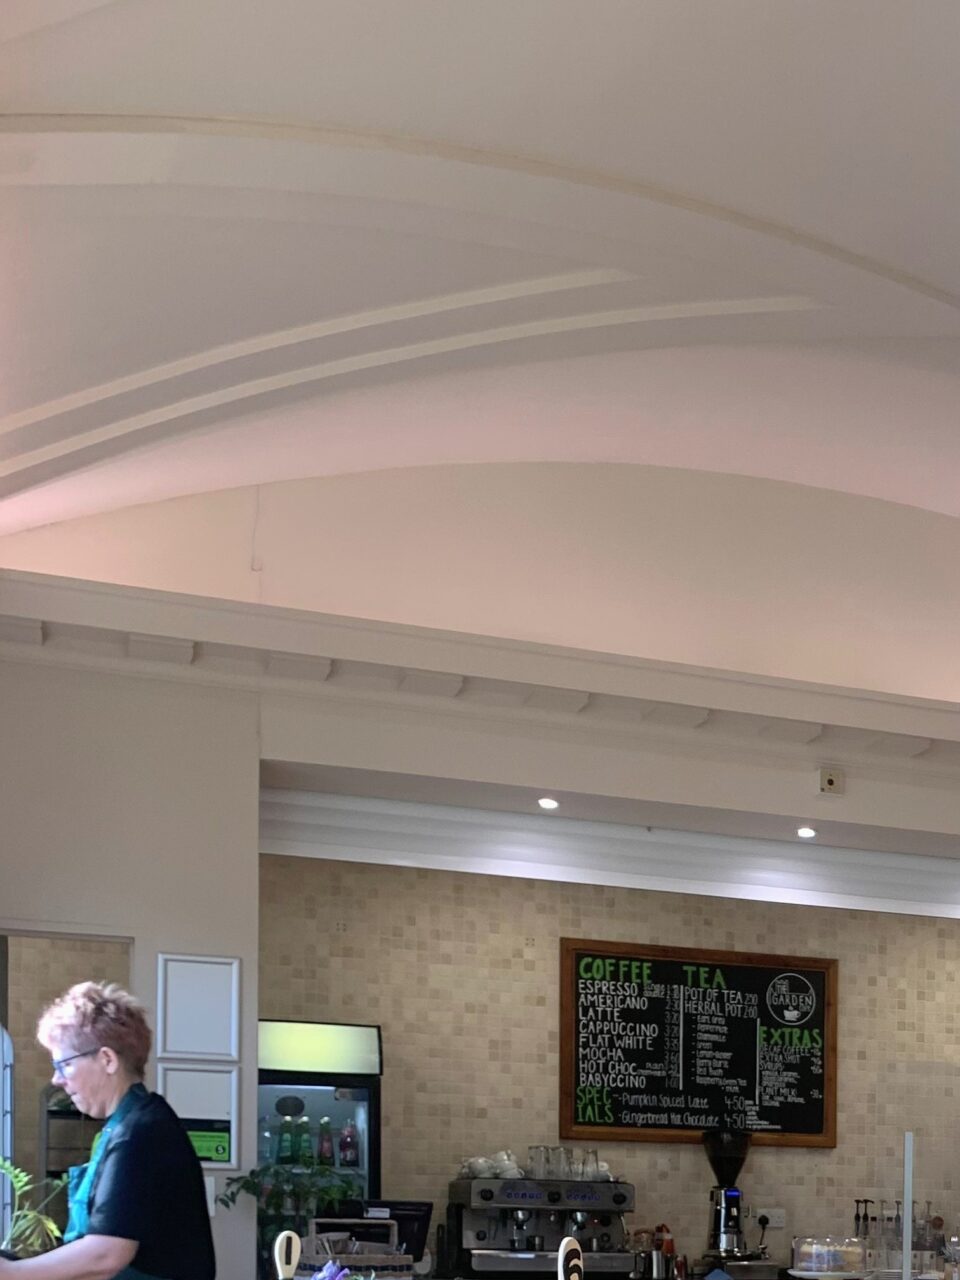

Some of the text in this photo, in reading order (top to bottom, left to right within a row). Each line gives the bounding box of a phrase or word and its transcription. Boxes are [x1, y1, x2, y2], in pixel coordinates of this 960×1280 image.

[579, 957, 653, 985] COFFEE
[682, 965, 727, 990] TEA
[578, 979, 639, 997] ESPRESSO
[685, 987, 704, 1001] POT
[706, 989, 719, 1002] OF
[722, 990, 743, 1004] TEA
[578, 994, 649, 1011] AMERICANO
[771, 994, 813, 1007] GARDEN
[578, 1007, 622, 1022] LATTE
[685, 1001, 724, 1016] HERBAL
[725, 1003, 744, 1018] POT
[579, 1021, 659, 1038] CAPPUCCINO
[758, 1026, 822, 1049] EXTRAS
[578, 1033, 611, 1048] FLAT
[613, 1035, 655, 1051] WHITE
[578, 1047, 625, 1061] MOCHA
[579, 1060, 606, 1073] HOT
[607, 1062, 637, 1076] CHOC
[580, 1073, 647, 1089] BABYCCINO
[576, 1086, 612, 1105] SPEC
[622, 1092, 658, 1108] Pumpkin
[659, 1093, 686, 1108] Spiced
[687, 1095, 710, 1109] Latte
[576, 1104, 615, 1123] IALS
[621, 1110, 669, 1128] Gingerbread
[683, 1112, 720, 1127] Chocolate
